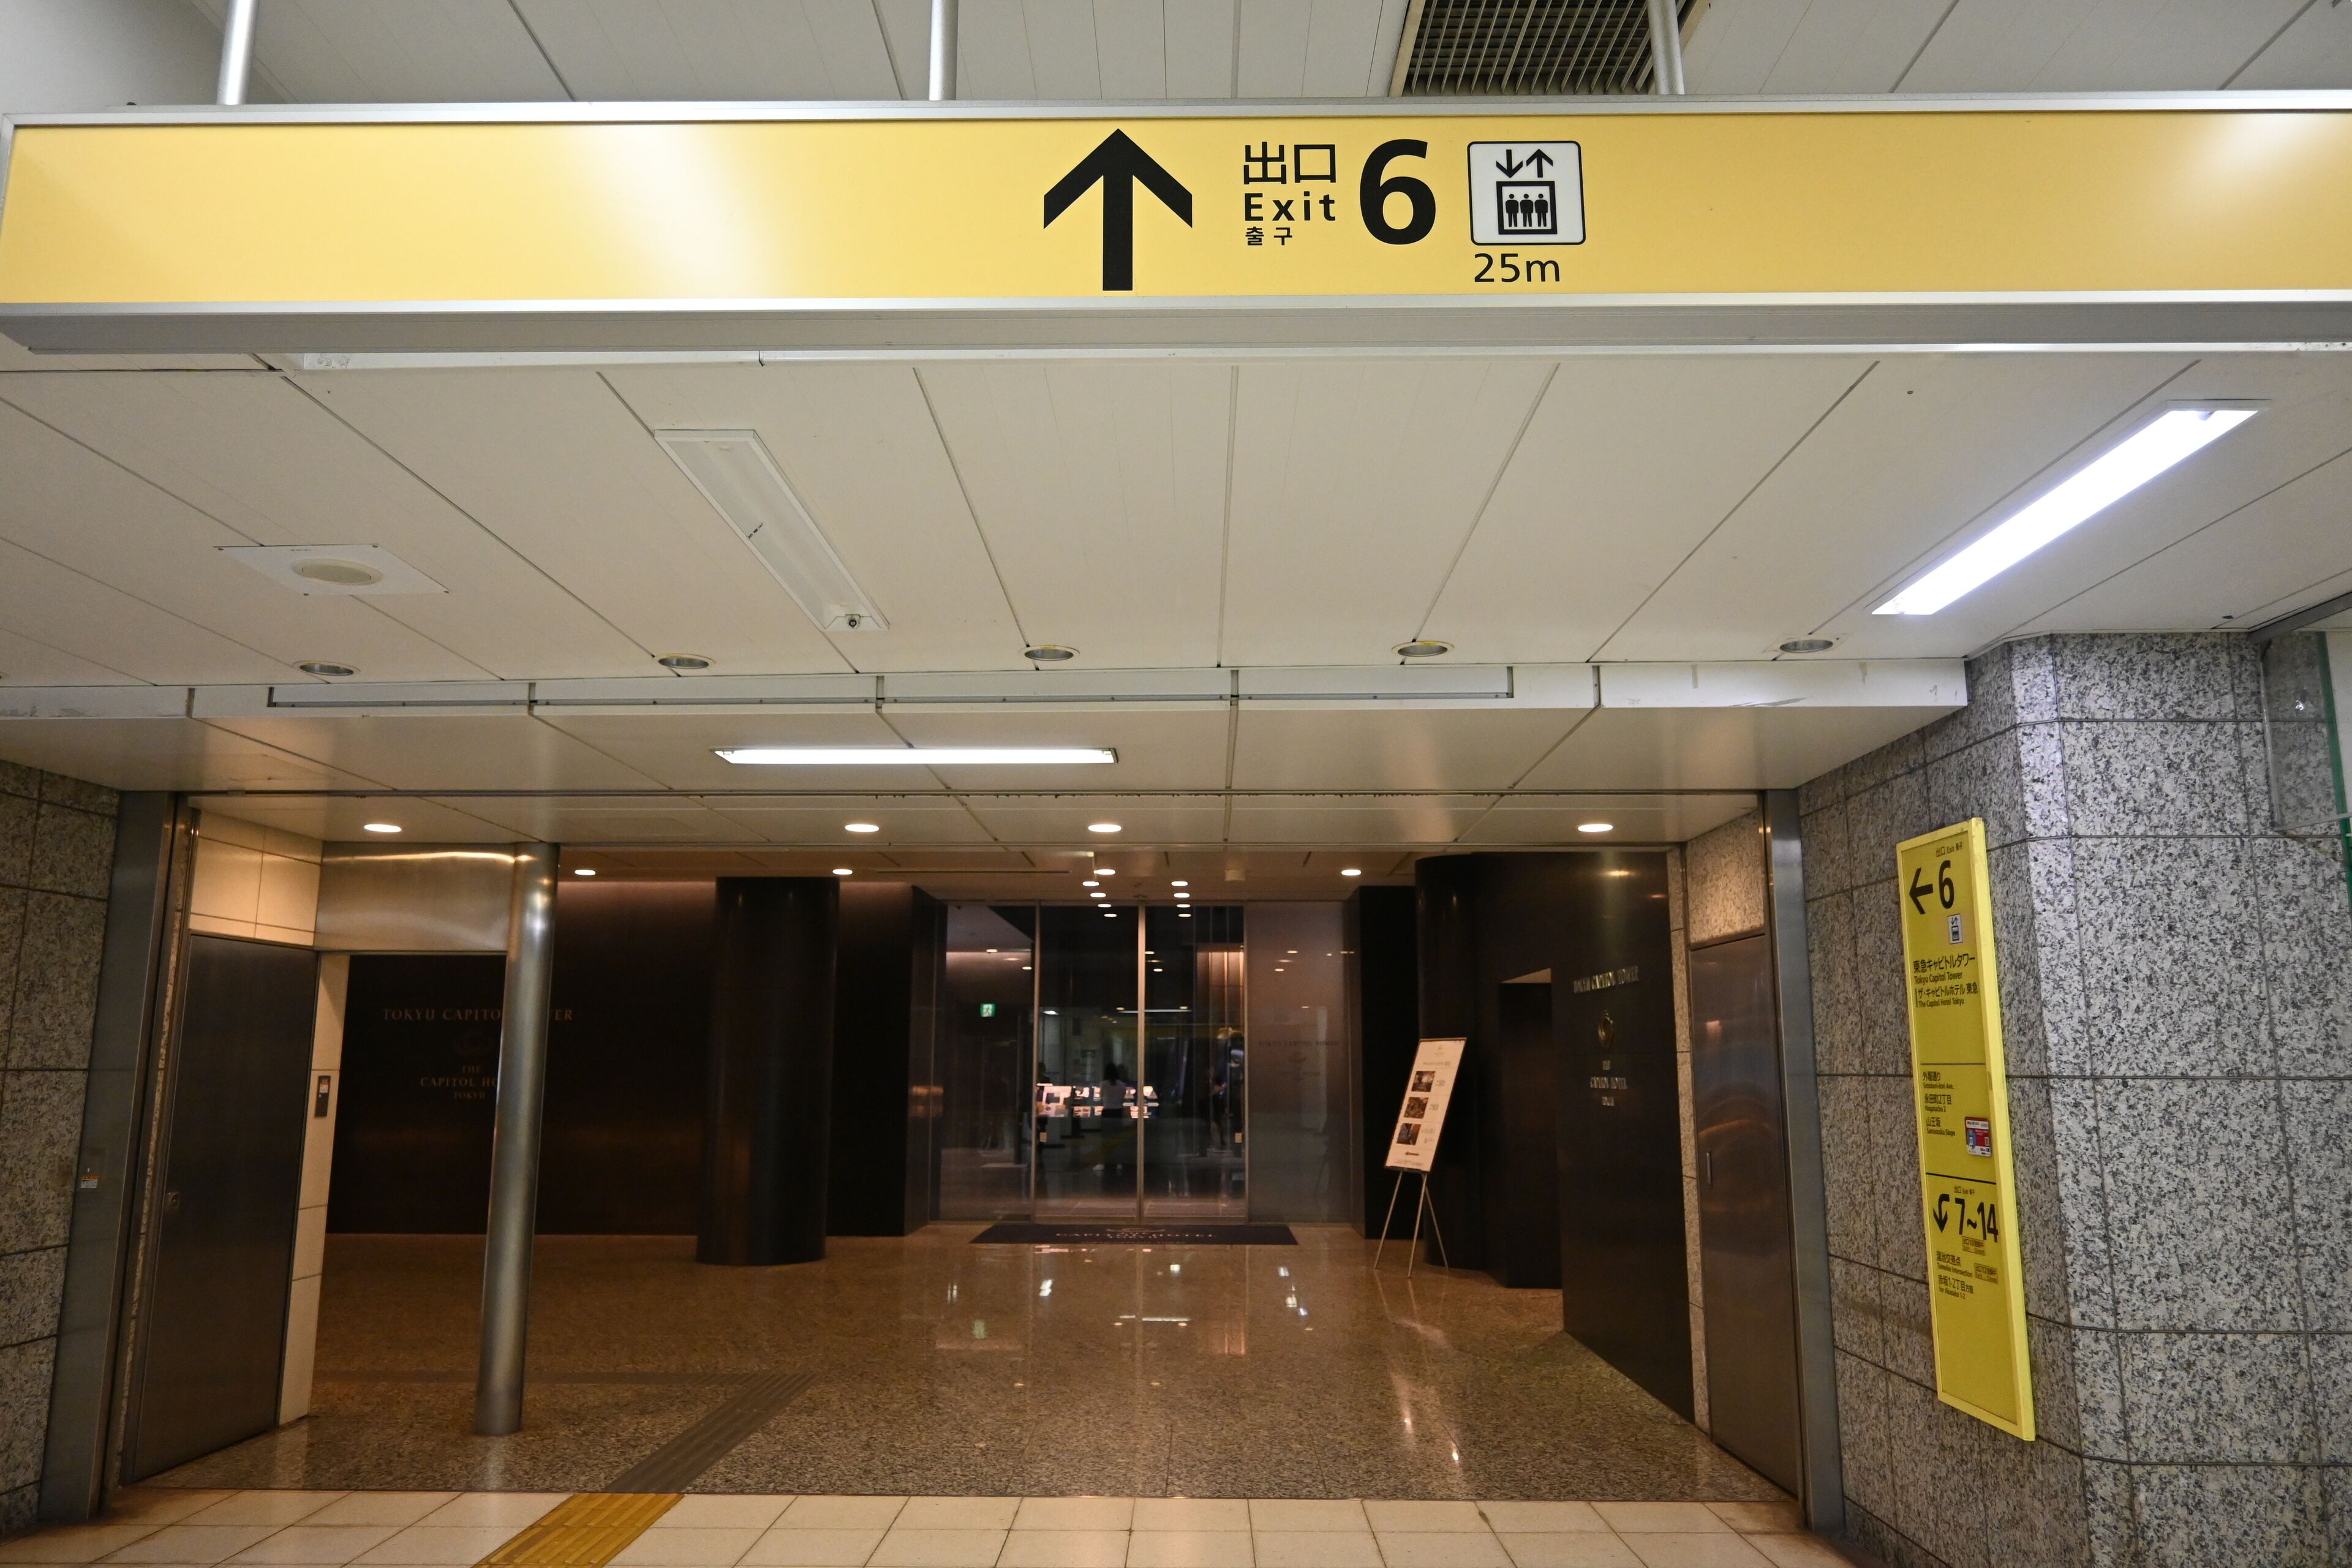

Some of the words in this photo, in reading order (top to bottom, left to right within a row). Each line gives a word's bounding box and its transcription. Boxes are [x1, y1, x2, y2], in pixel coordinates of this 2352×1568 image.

[1243, 141, 1336, 185] 出口
[1359, 139, 1436, 245] 6
[1245, 191, 1336, 222] Exit
[1245, 227, 1293, 246] 출구
[1474, 254, 1560, 283] 25m
[1939, 860, 1954, 909] 6
[1913, 954, 1975, 973] 東急キャピトルタワー
[1914, 976, 1928, 985] Tokyu
[1929, 972, 1945, 983] Capitol
[1947, 971, 1962, 980] Tower
[382, 1009, 435, 1020] TOKYU
[443, 1009, 502, 1021] CAPITO
[420, 1078, 476, 1088] CAPITOL
